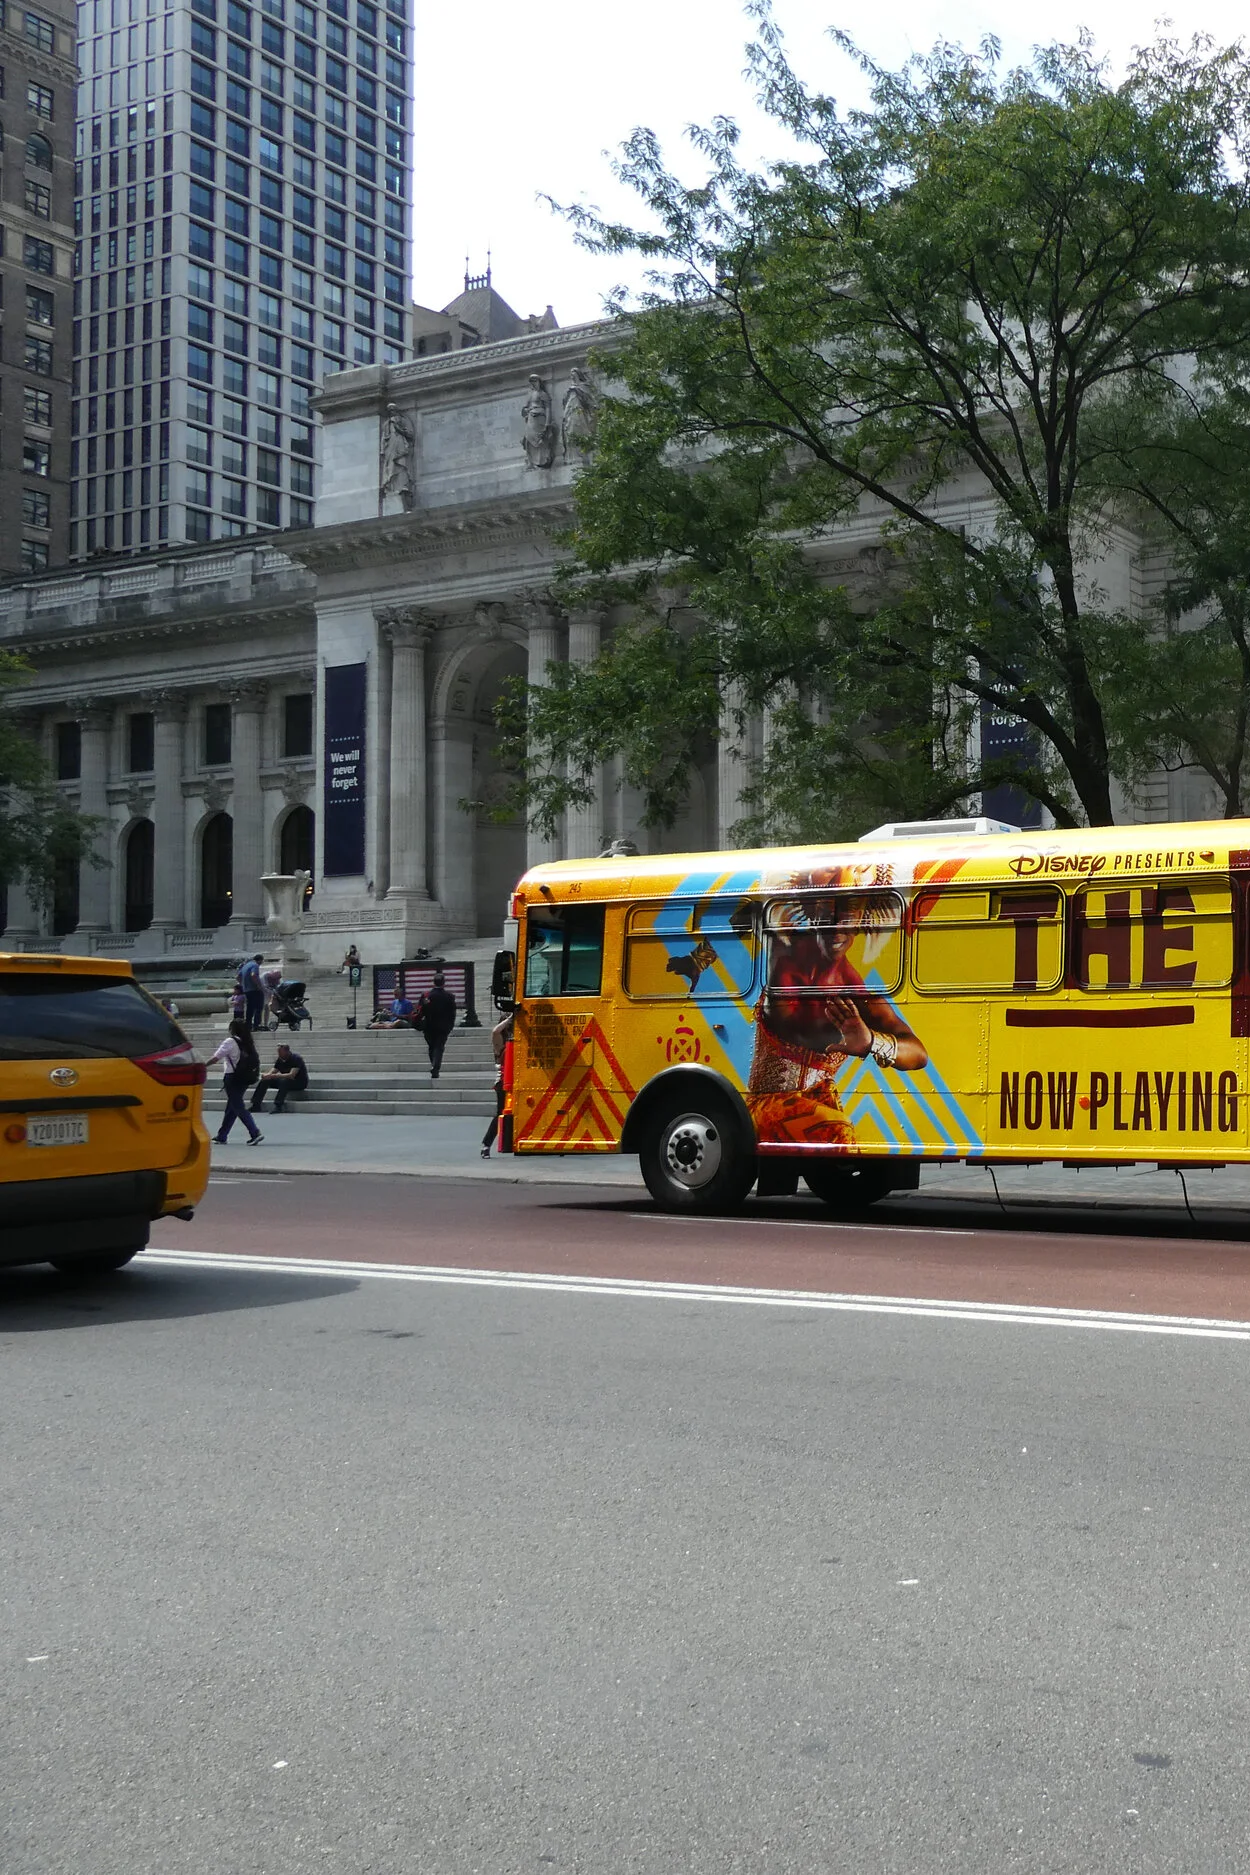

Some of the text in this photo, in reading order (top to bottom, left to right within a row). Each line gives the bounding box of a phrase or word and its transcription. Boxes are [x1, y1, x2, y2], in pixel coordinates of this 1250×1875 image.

[330, 750, 360, 763] We will
[333, 765, 357, 775] never
[332, 776, 358, 790] forget
[1114, 850, 1196, 869] PRESENTS
[998, 886, 1198, 990] THE
[1000, 1070, 1078, 1131] NOW
[1089, 1070, 1238, 1132] PLAYING
